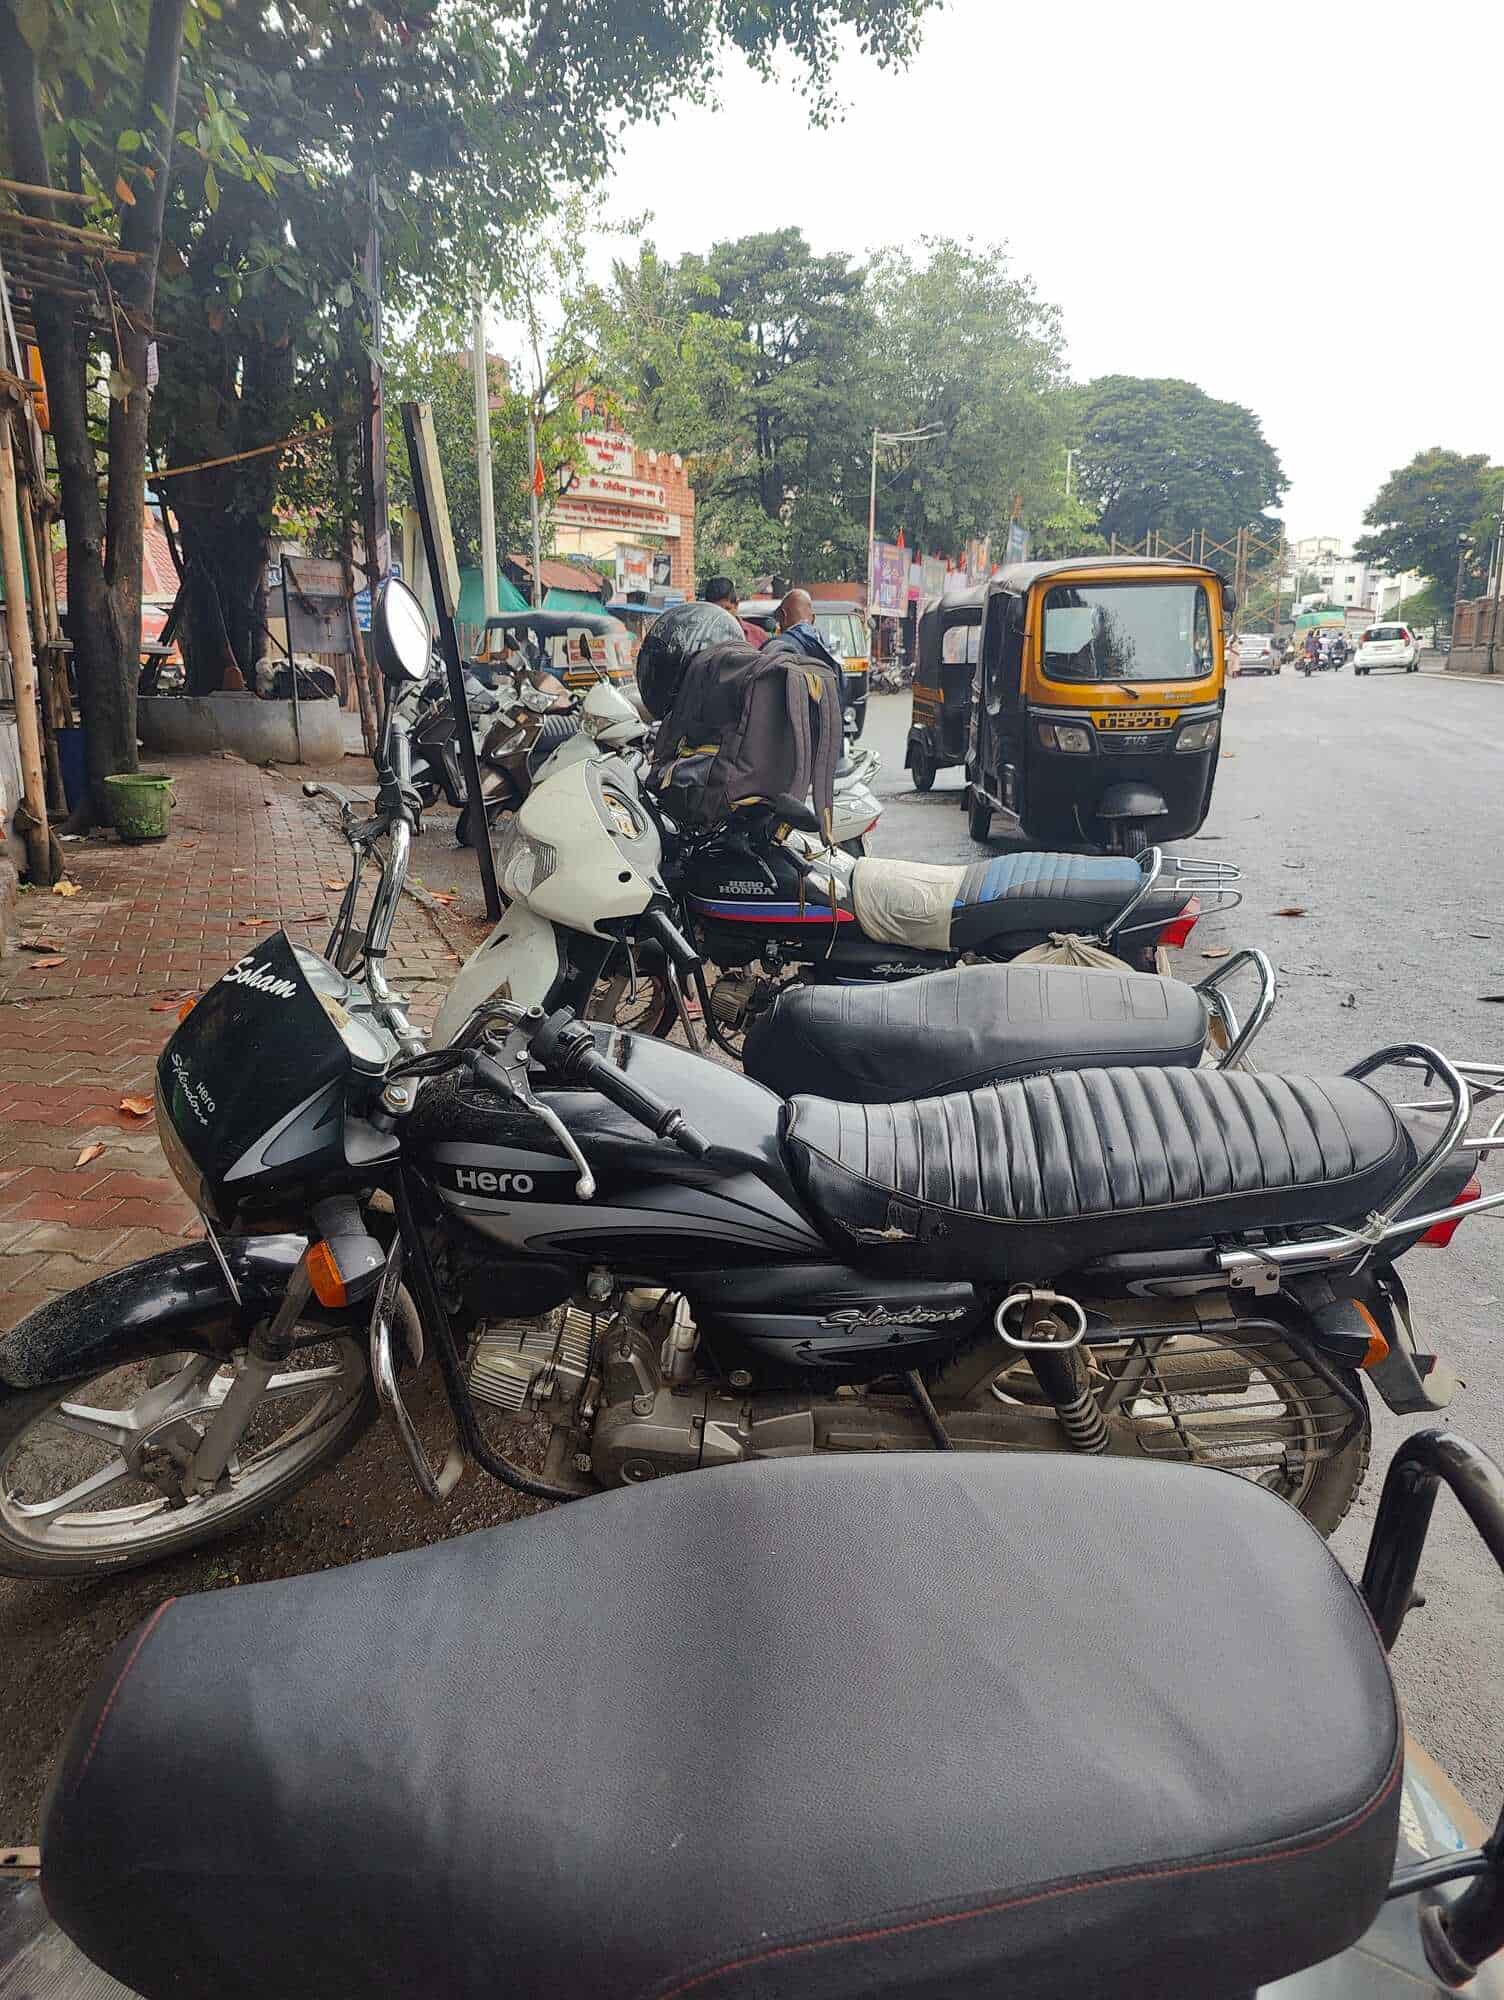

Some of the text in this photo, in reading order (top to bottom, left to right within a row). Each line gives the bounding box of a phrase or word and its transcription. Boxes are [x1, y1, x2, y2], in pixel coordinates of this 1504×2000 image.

[1122, 735, 1149, 745] TVS
[719, 885, 775, 896] HONDA
[728, 880, 764, 888] HERO
[222, 956, 297, 998] Soham
[196, 1082, 216, 1113] Hero
[455, 1169, 534, 1194] Hero
